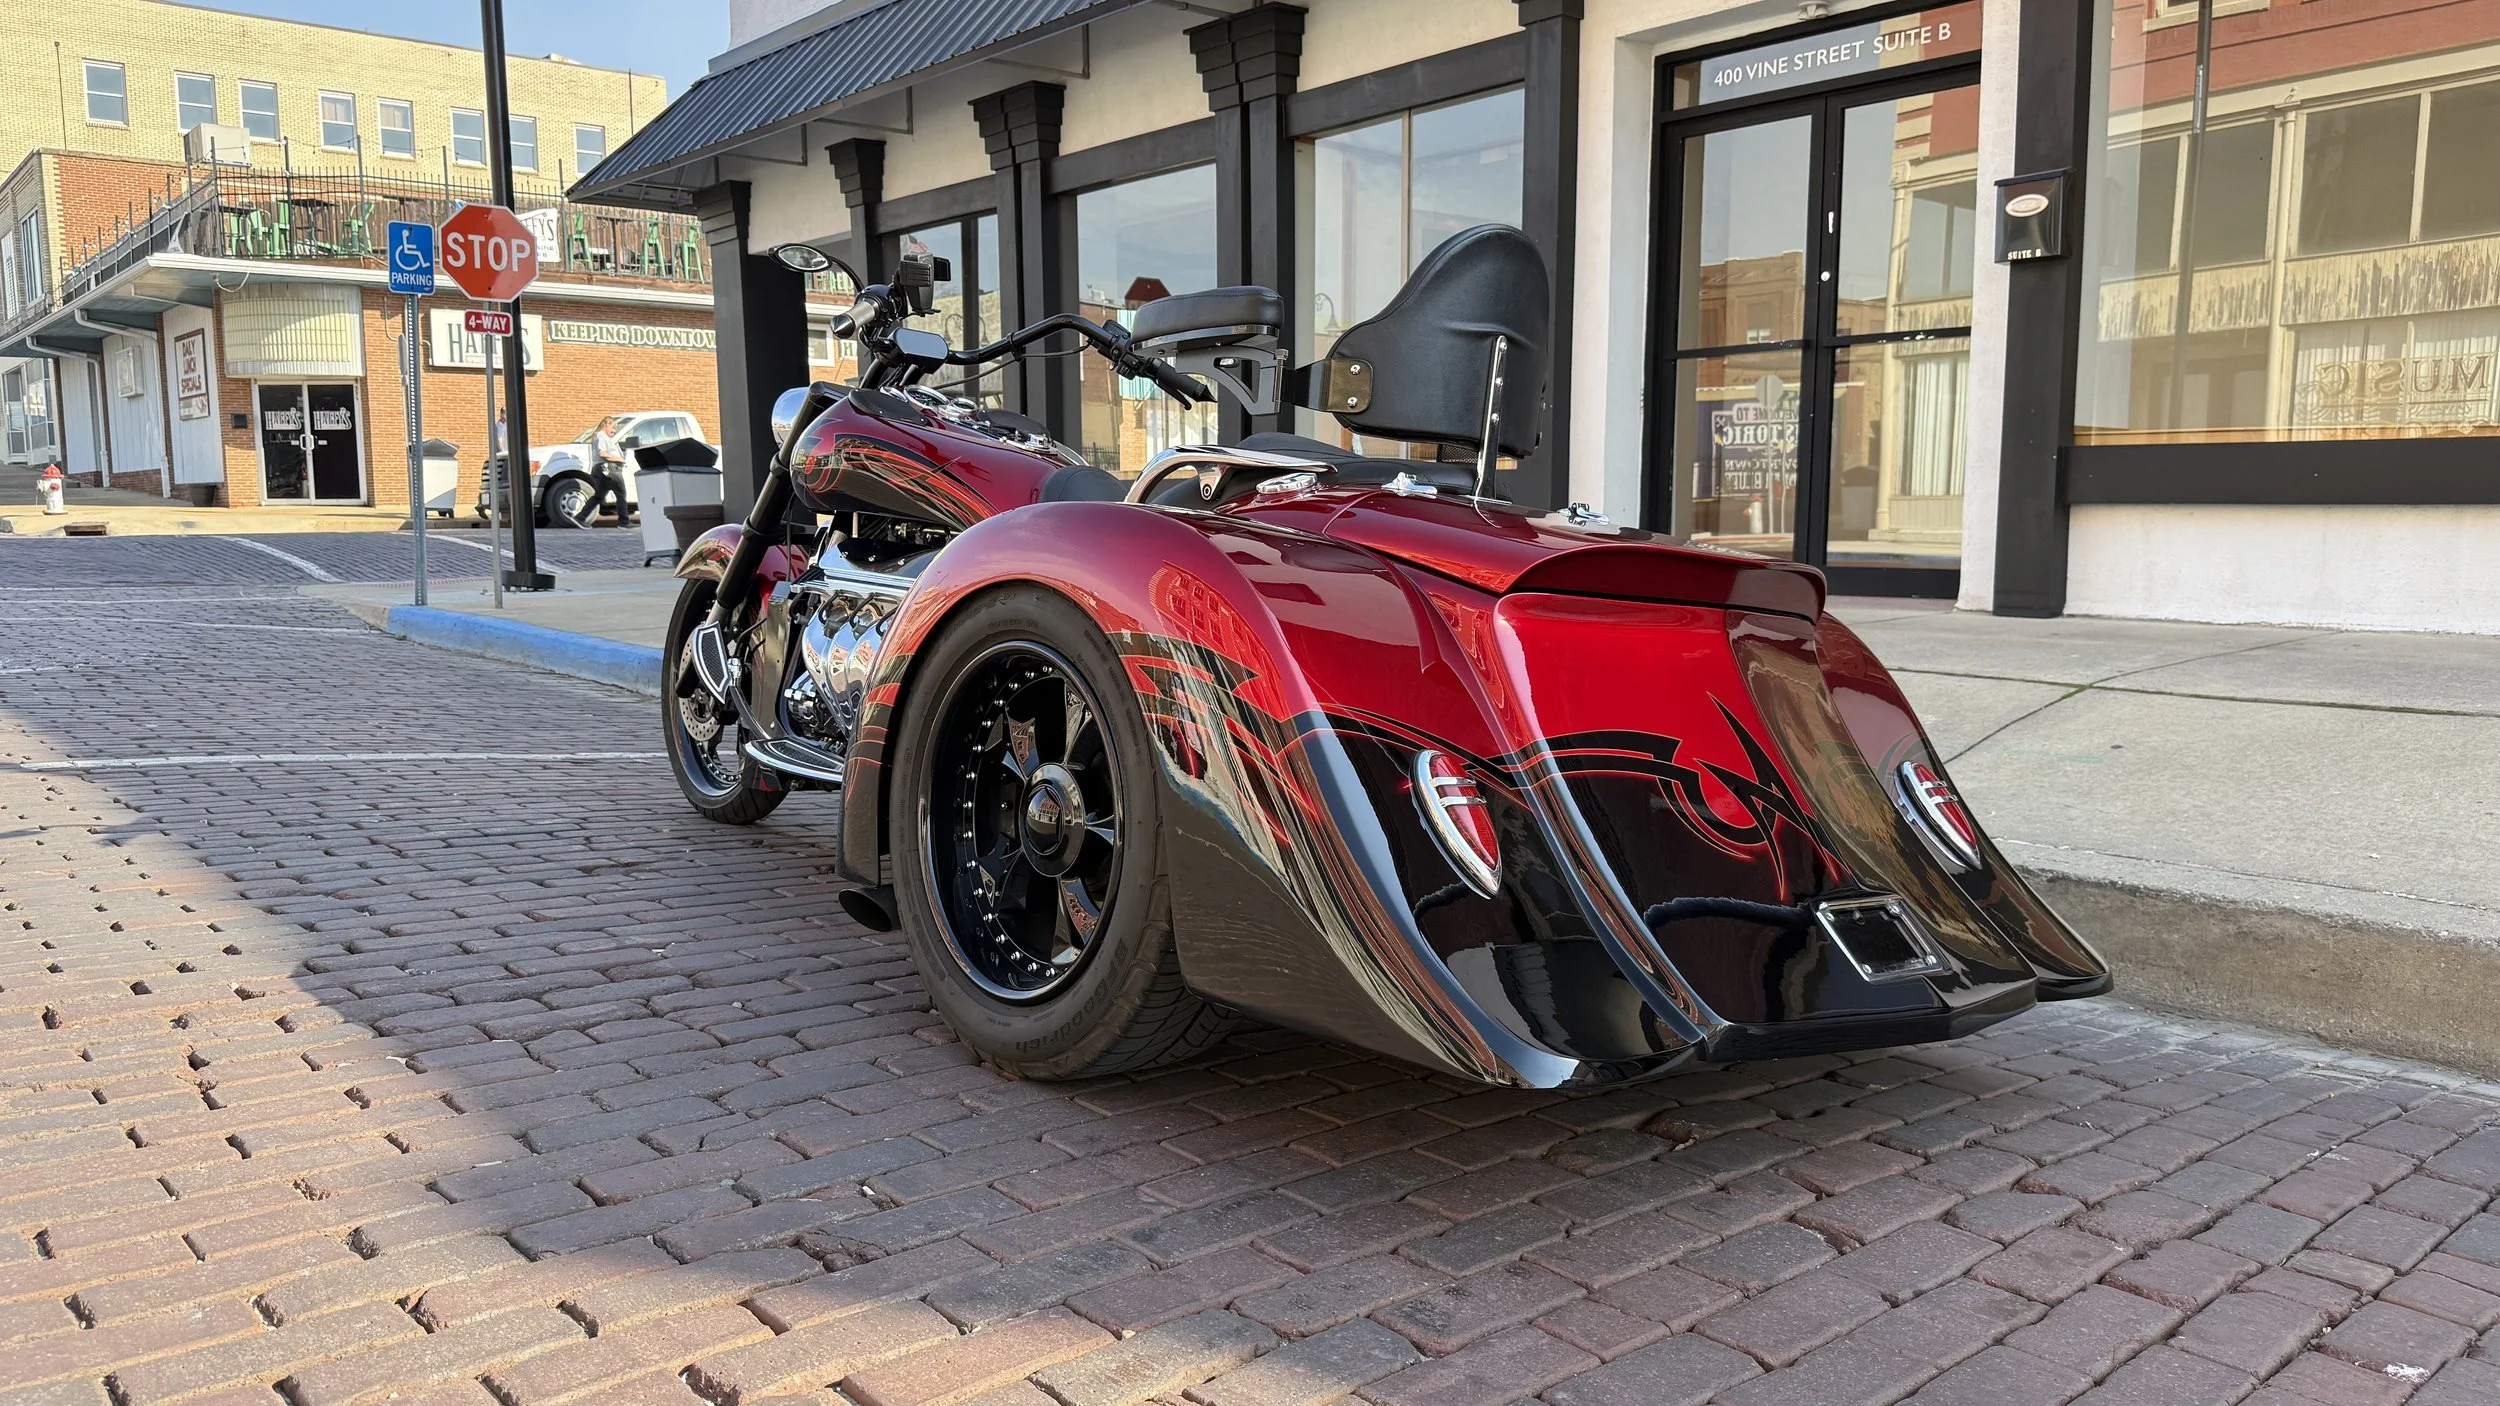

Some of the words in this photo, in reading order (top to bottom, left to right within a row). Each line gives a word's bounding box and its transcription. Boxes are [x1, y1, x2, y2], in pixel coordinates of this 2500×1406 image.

[1714, 67, 1742, 87] 400
[1746, 57, 1788, 80] VINE
[1793, 40, 1864, 71] STREET
[1873, 25, 1932, 54] SUITE
[1939, 22, 1951, 41] B
[446, 231, 531, 273] STOP
[2008, 249, 2032, 260] SUITE
[2035, 248, 2042, 257] B
[391, 271, 432, 286] PARKING
[468, 314, 508, 331] 4-WAY
[553, 322, 628, 343] KEEPING
[630, 326, 717, 348] DOWNTOW
